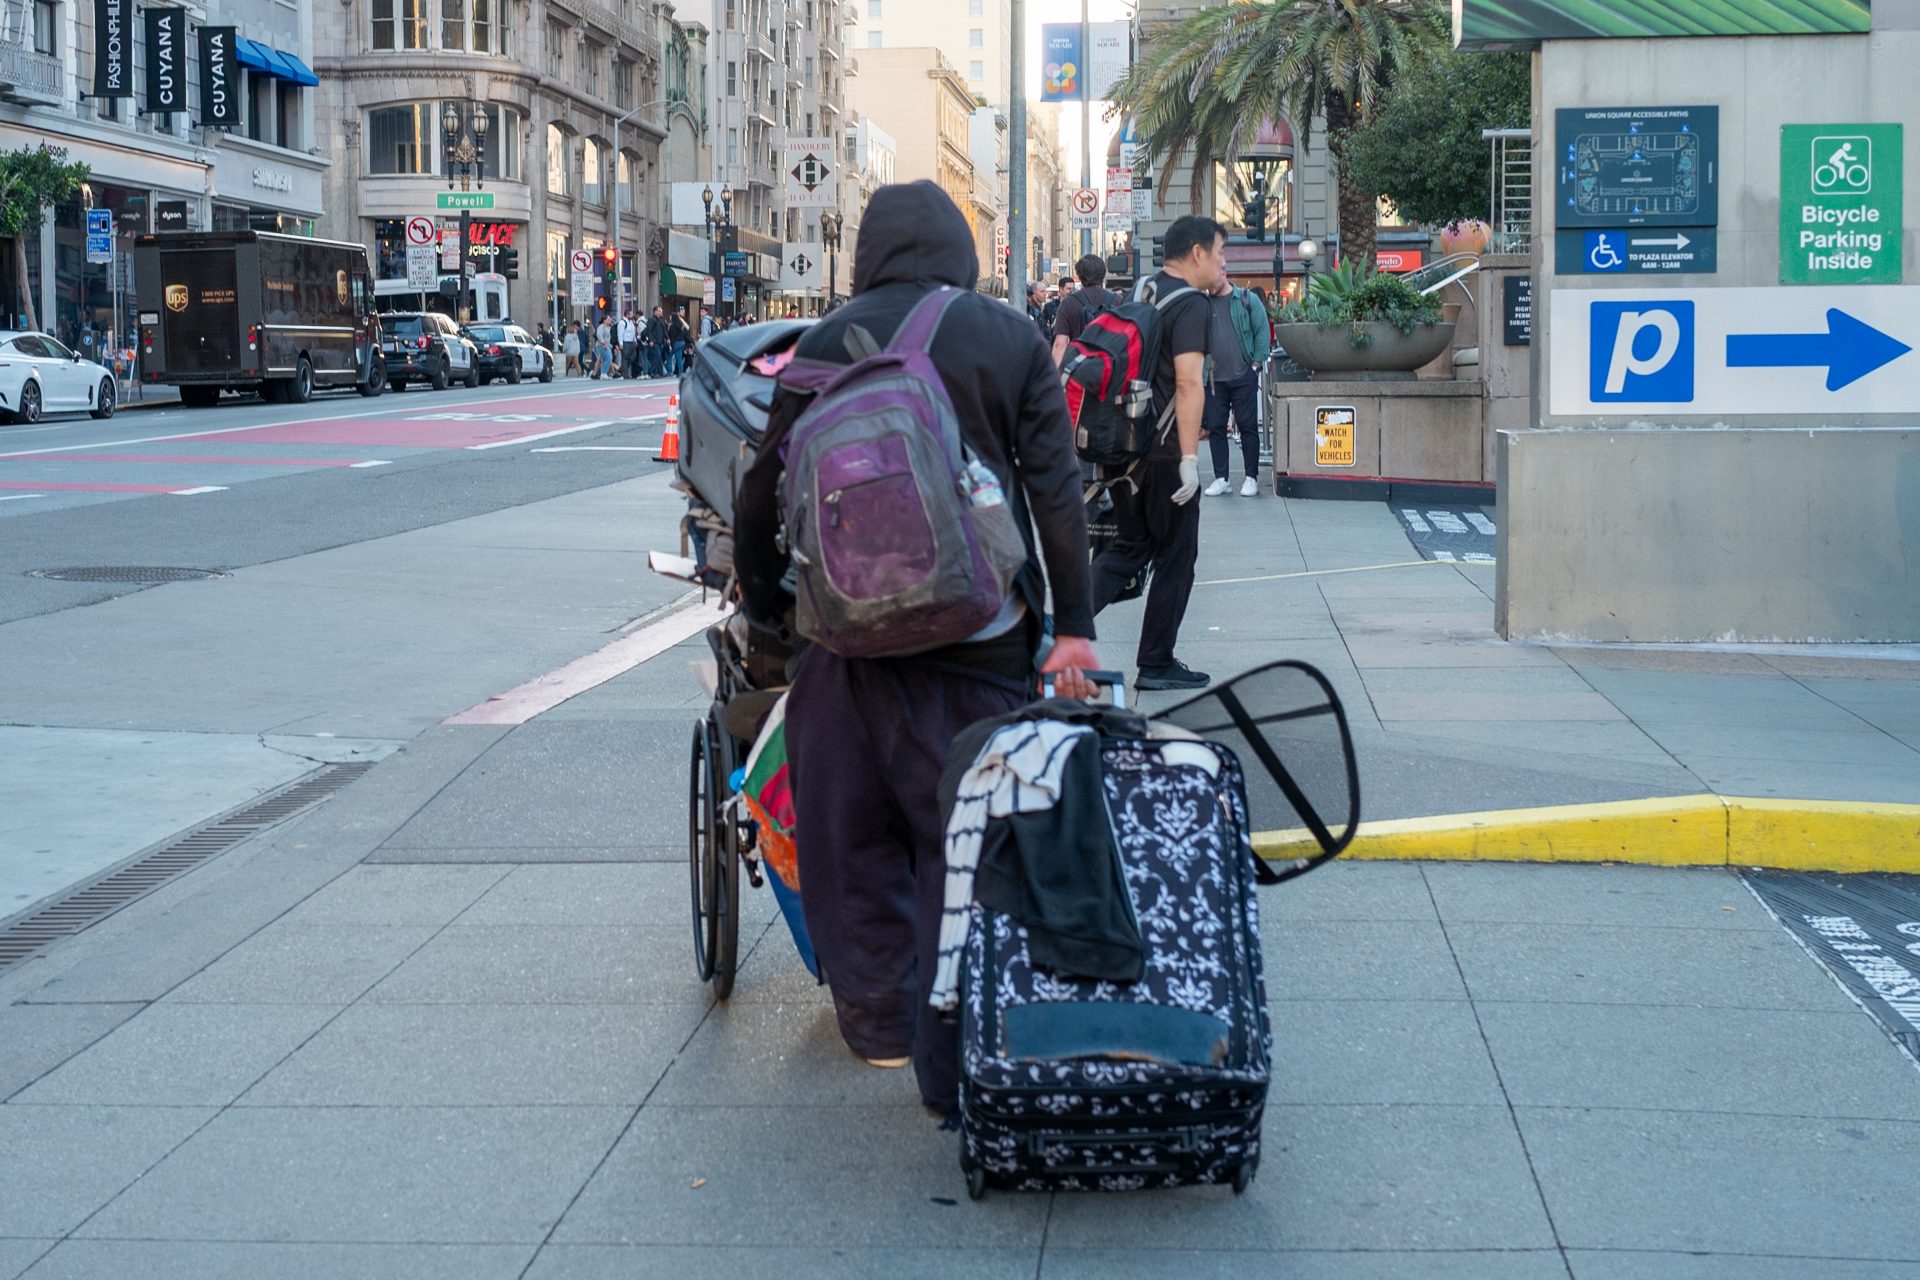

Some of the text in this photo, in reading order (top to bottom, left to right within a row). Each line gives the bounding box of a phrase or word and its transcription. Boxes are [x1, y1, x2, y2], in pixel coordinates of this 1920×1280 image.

[158, 15, 174, 105] CUYANA
[211, 33, 226, 118] CUYANA
[1607, 111, 1632, 119] SQUARE
[1669, 110, 1689, 118] PATHS
[40, 138, 62, 158] dson
[447, 196, 483, 207] Powell
[162, 210, 182, 221] dyson
[1074, 217, 1083, 225] ON
[1085, 217, 1098, 225] RED
[1802, 205, 1880, 227] Bicycle
[1800, 230, 1882, 252] Parking
[1628, 252, 1694, 261] TO PLAZA ELEVATOR
[1808, 251, 1873, 270] Inside
[1641, 261, 1657, 269] 6AM
[1661, 261, 1681, 269] 12AM
[168, 292, 187, 308] ups
[1324, 428, 1347, 437] WATCH
[1329, 440, 1343, 449] FOR
[1319, 451, 1352, 461] VEHICLES
